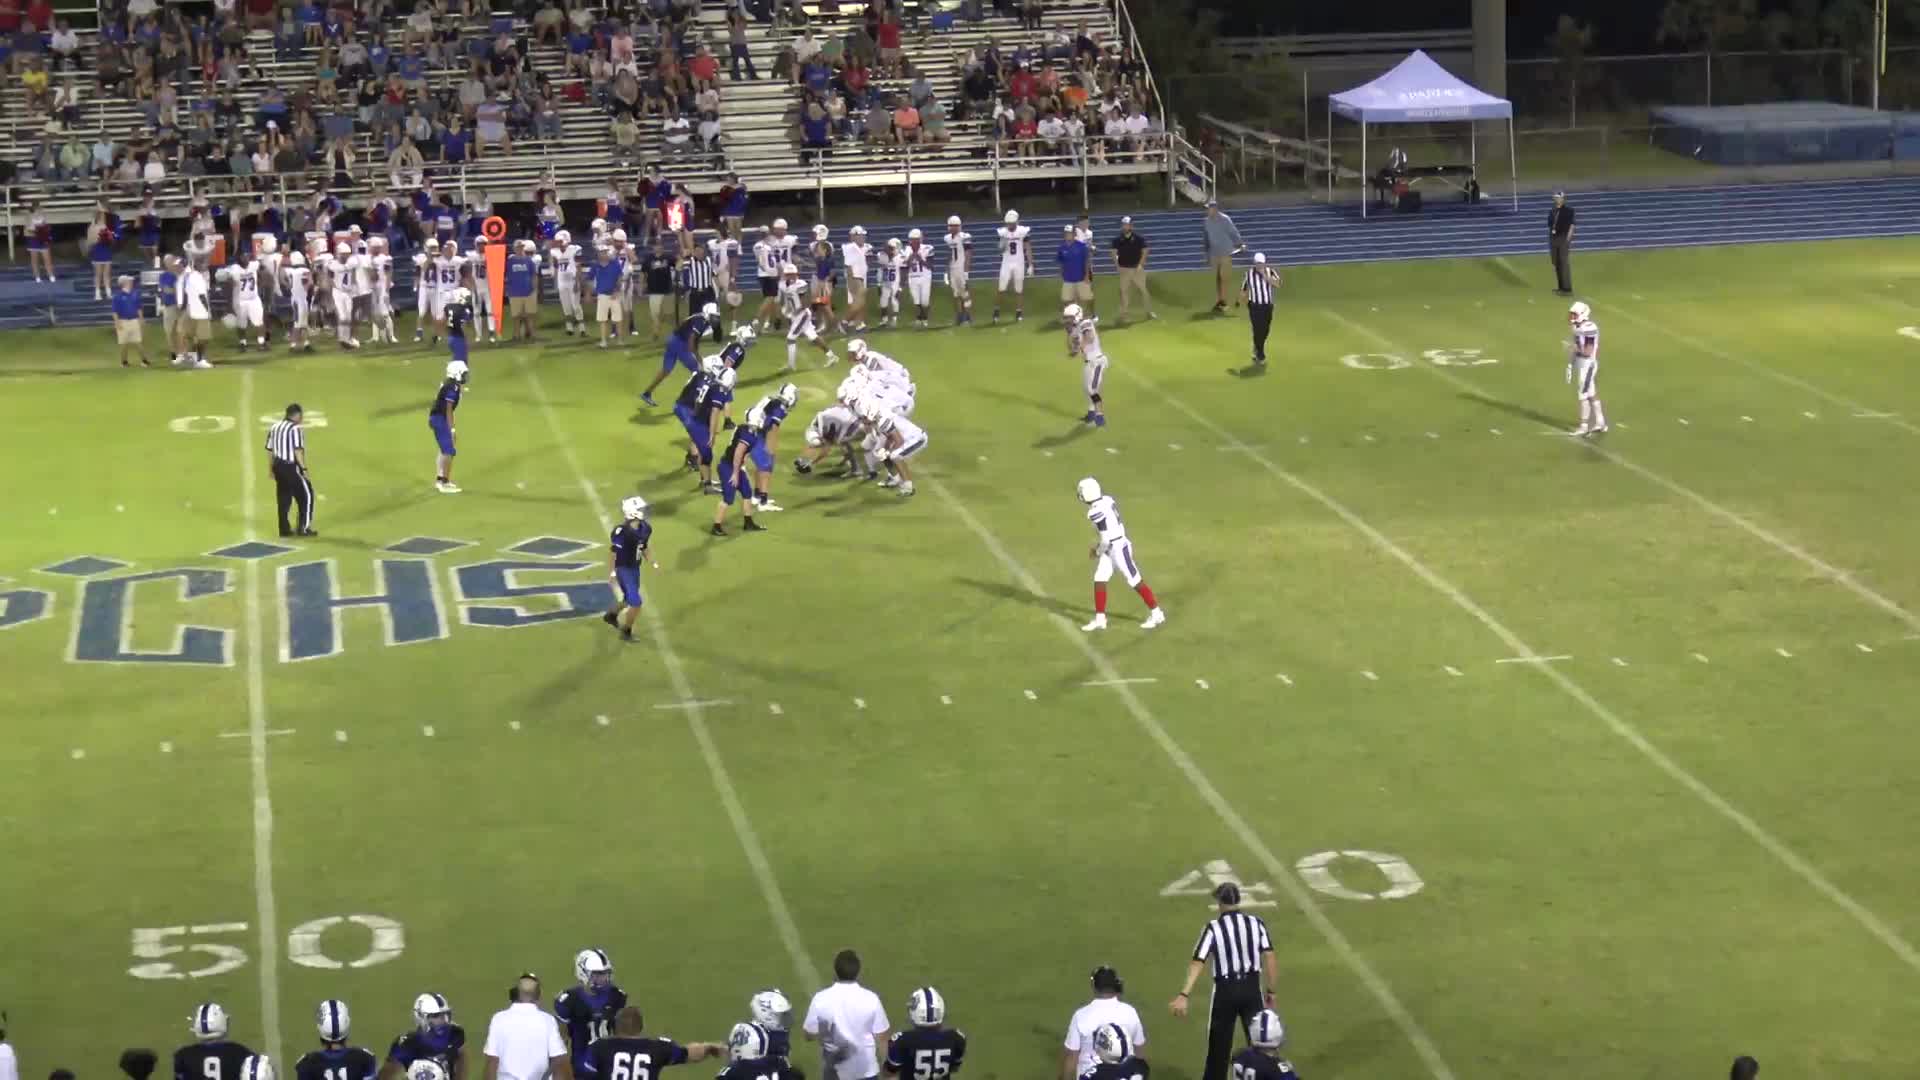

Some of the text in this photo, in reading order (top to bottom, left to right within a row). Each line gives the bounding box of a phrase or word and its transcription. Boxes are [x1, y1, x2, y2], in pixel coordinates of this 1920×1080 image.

[1159, 849, 1425, 912] 40
[127, 914, 406, 979] 50
[203, 1056, 222, 1080] 9
[610, 1051, 652, 1080] 66
[913, 1048, 952, 1080] 55
